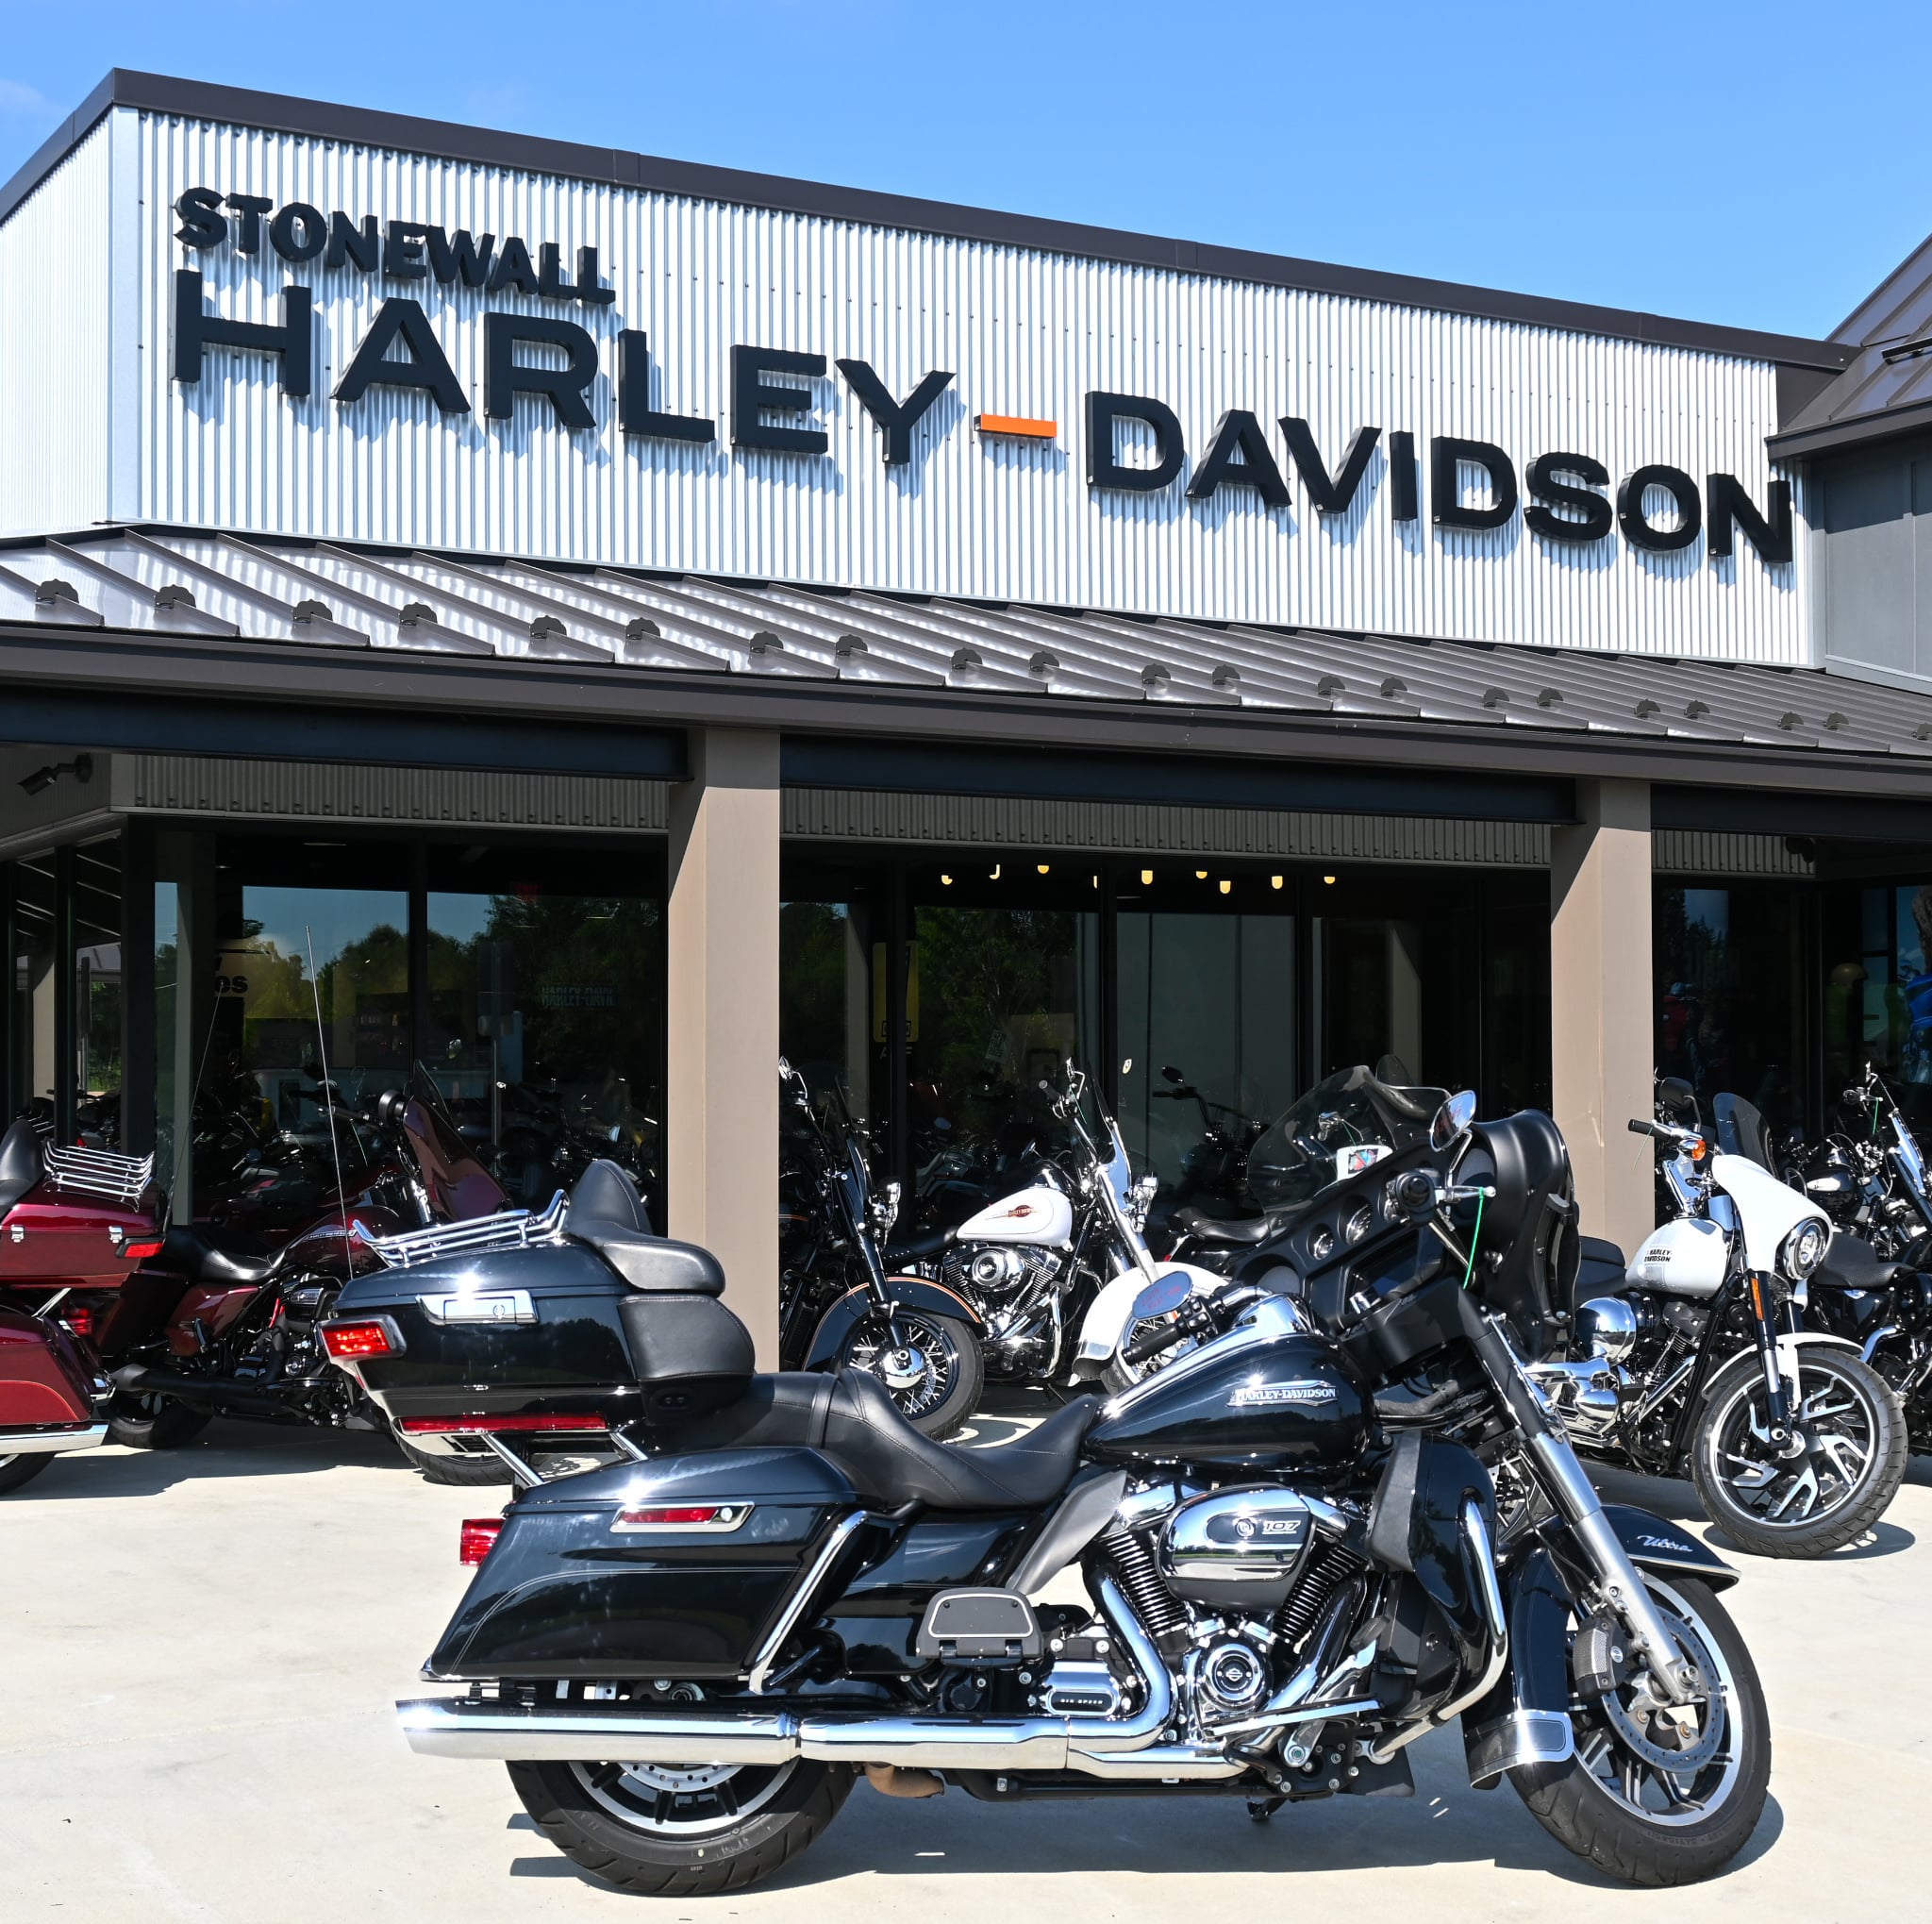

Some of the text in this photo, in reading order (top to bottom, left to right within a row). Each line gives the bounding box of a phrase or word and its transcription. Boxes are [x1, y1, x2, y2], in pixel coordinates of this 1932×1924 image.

[174, 187, 616, 305] STONEWALL
[1262, 1520, 1302, 1532] 107
[1637, 1534, 1693, 1552] Ultra
